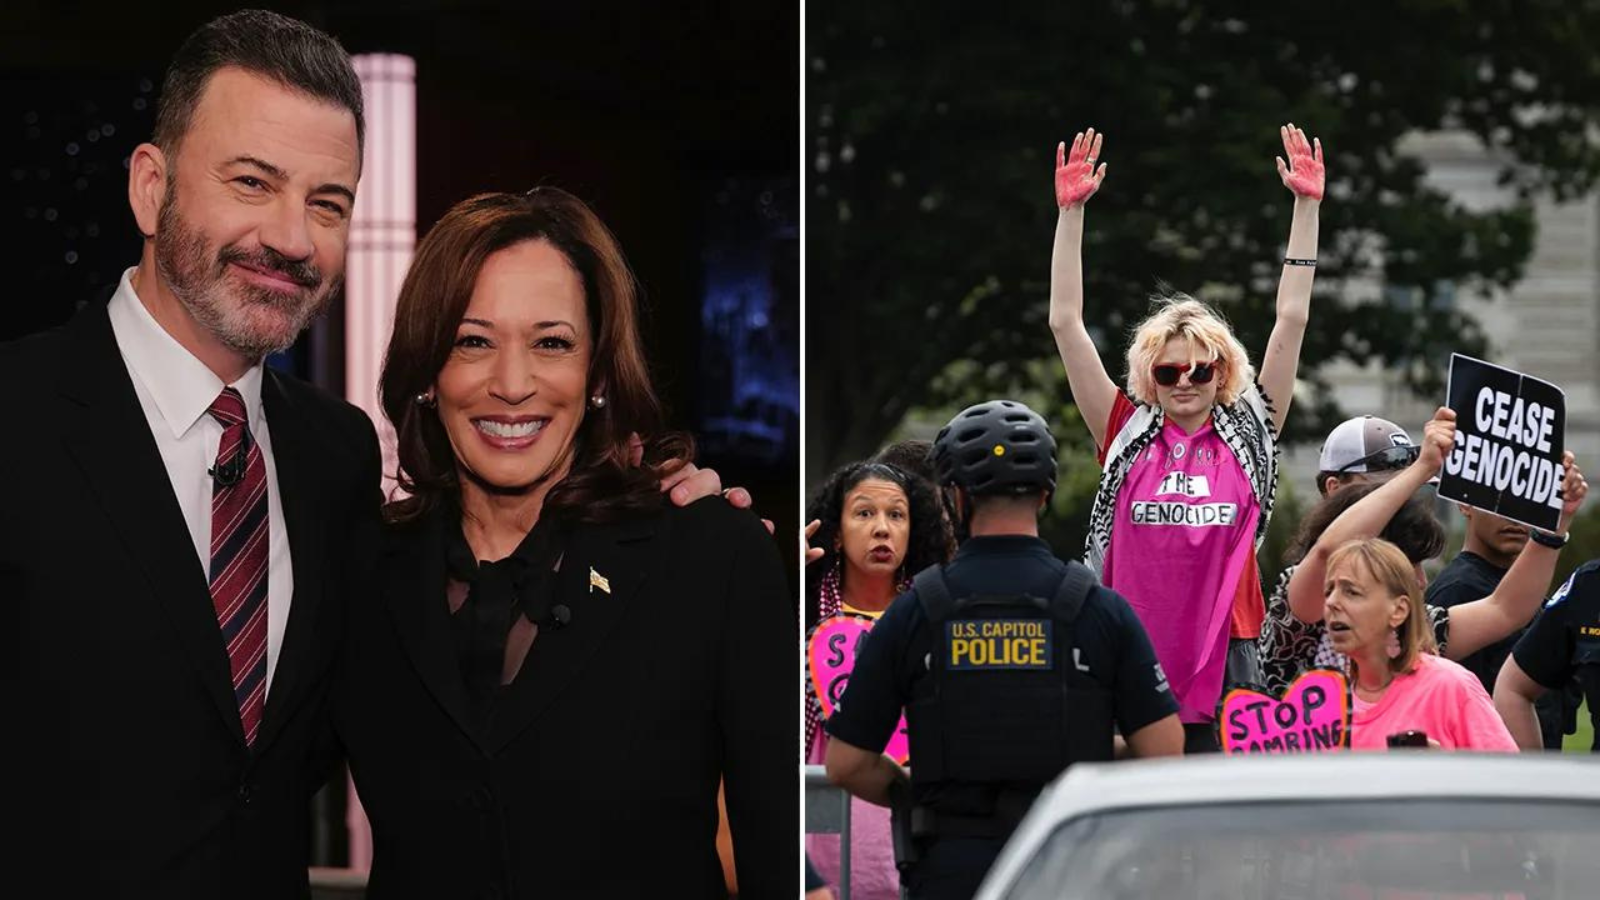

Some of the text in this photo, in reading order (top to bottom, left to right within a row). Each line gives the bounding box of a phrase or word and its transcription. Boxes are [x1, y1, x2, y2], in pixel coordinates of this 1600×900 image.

[1475, 386, 1555, 453] CEASE
[1161, 473, 1195, 494] THE
[1445, 430, 1565, 510] GENOCIDE
[952, 622, 1046, 637] U.S. CAPITOL
[951, 638, 1046, 665] POLICE
[1229, 685, 1326, 740] STOP
